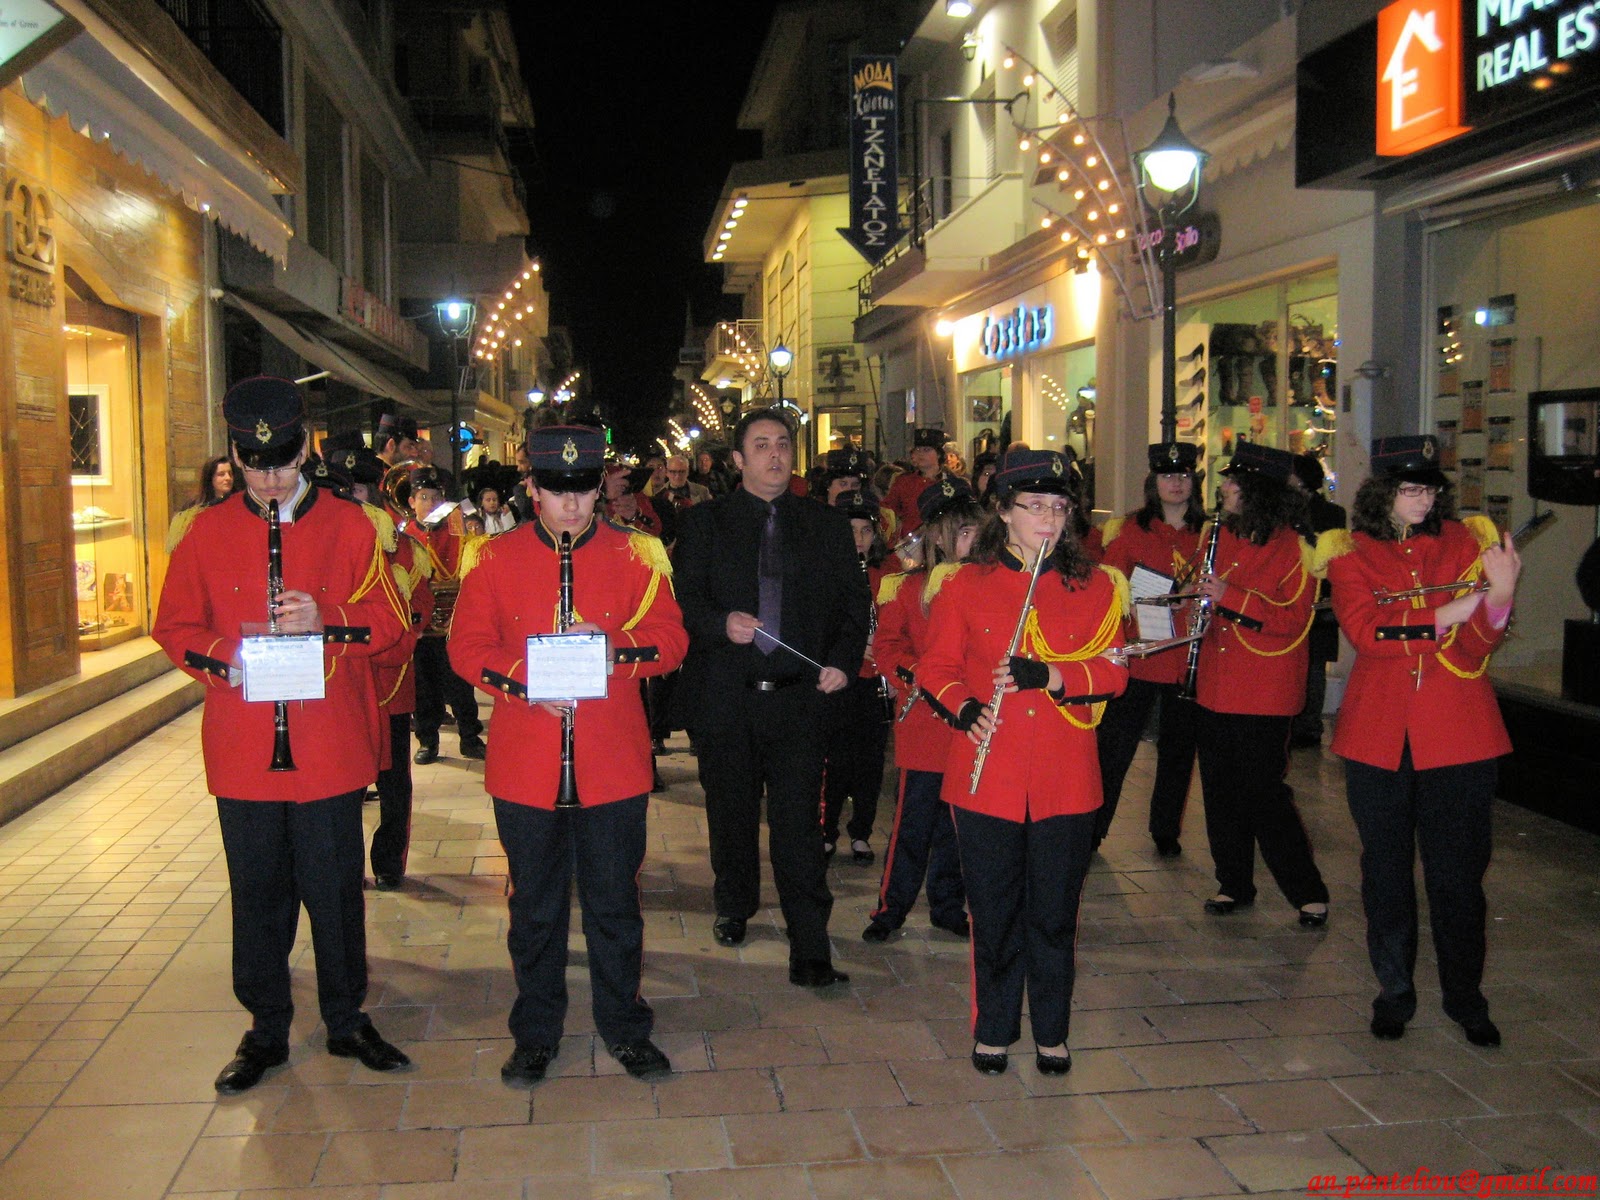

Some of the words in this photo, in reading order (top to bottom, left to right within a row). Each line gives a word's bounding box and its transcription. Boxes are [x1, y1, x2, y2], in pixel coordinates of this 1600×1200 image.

[854, 61, 892, 93] ΜΟΔΑ
[1477, 29, 1548, 91] REAL
[1557, 3, 1600, 58] ES
[862, 116, 888, 246] ΤΖΑΝΕΤΑΤΟΣ
